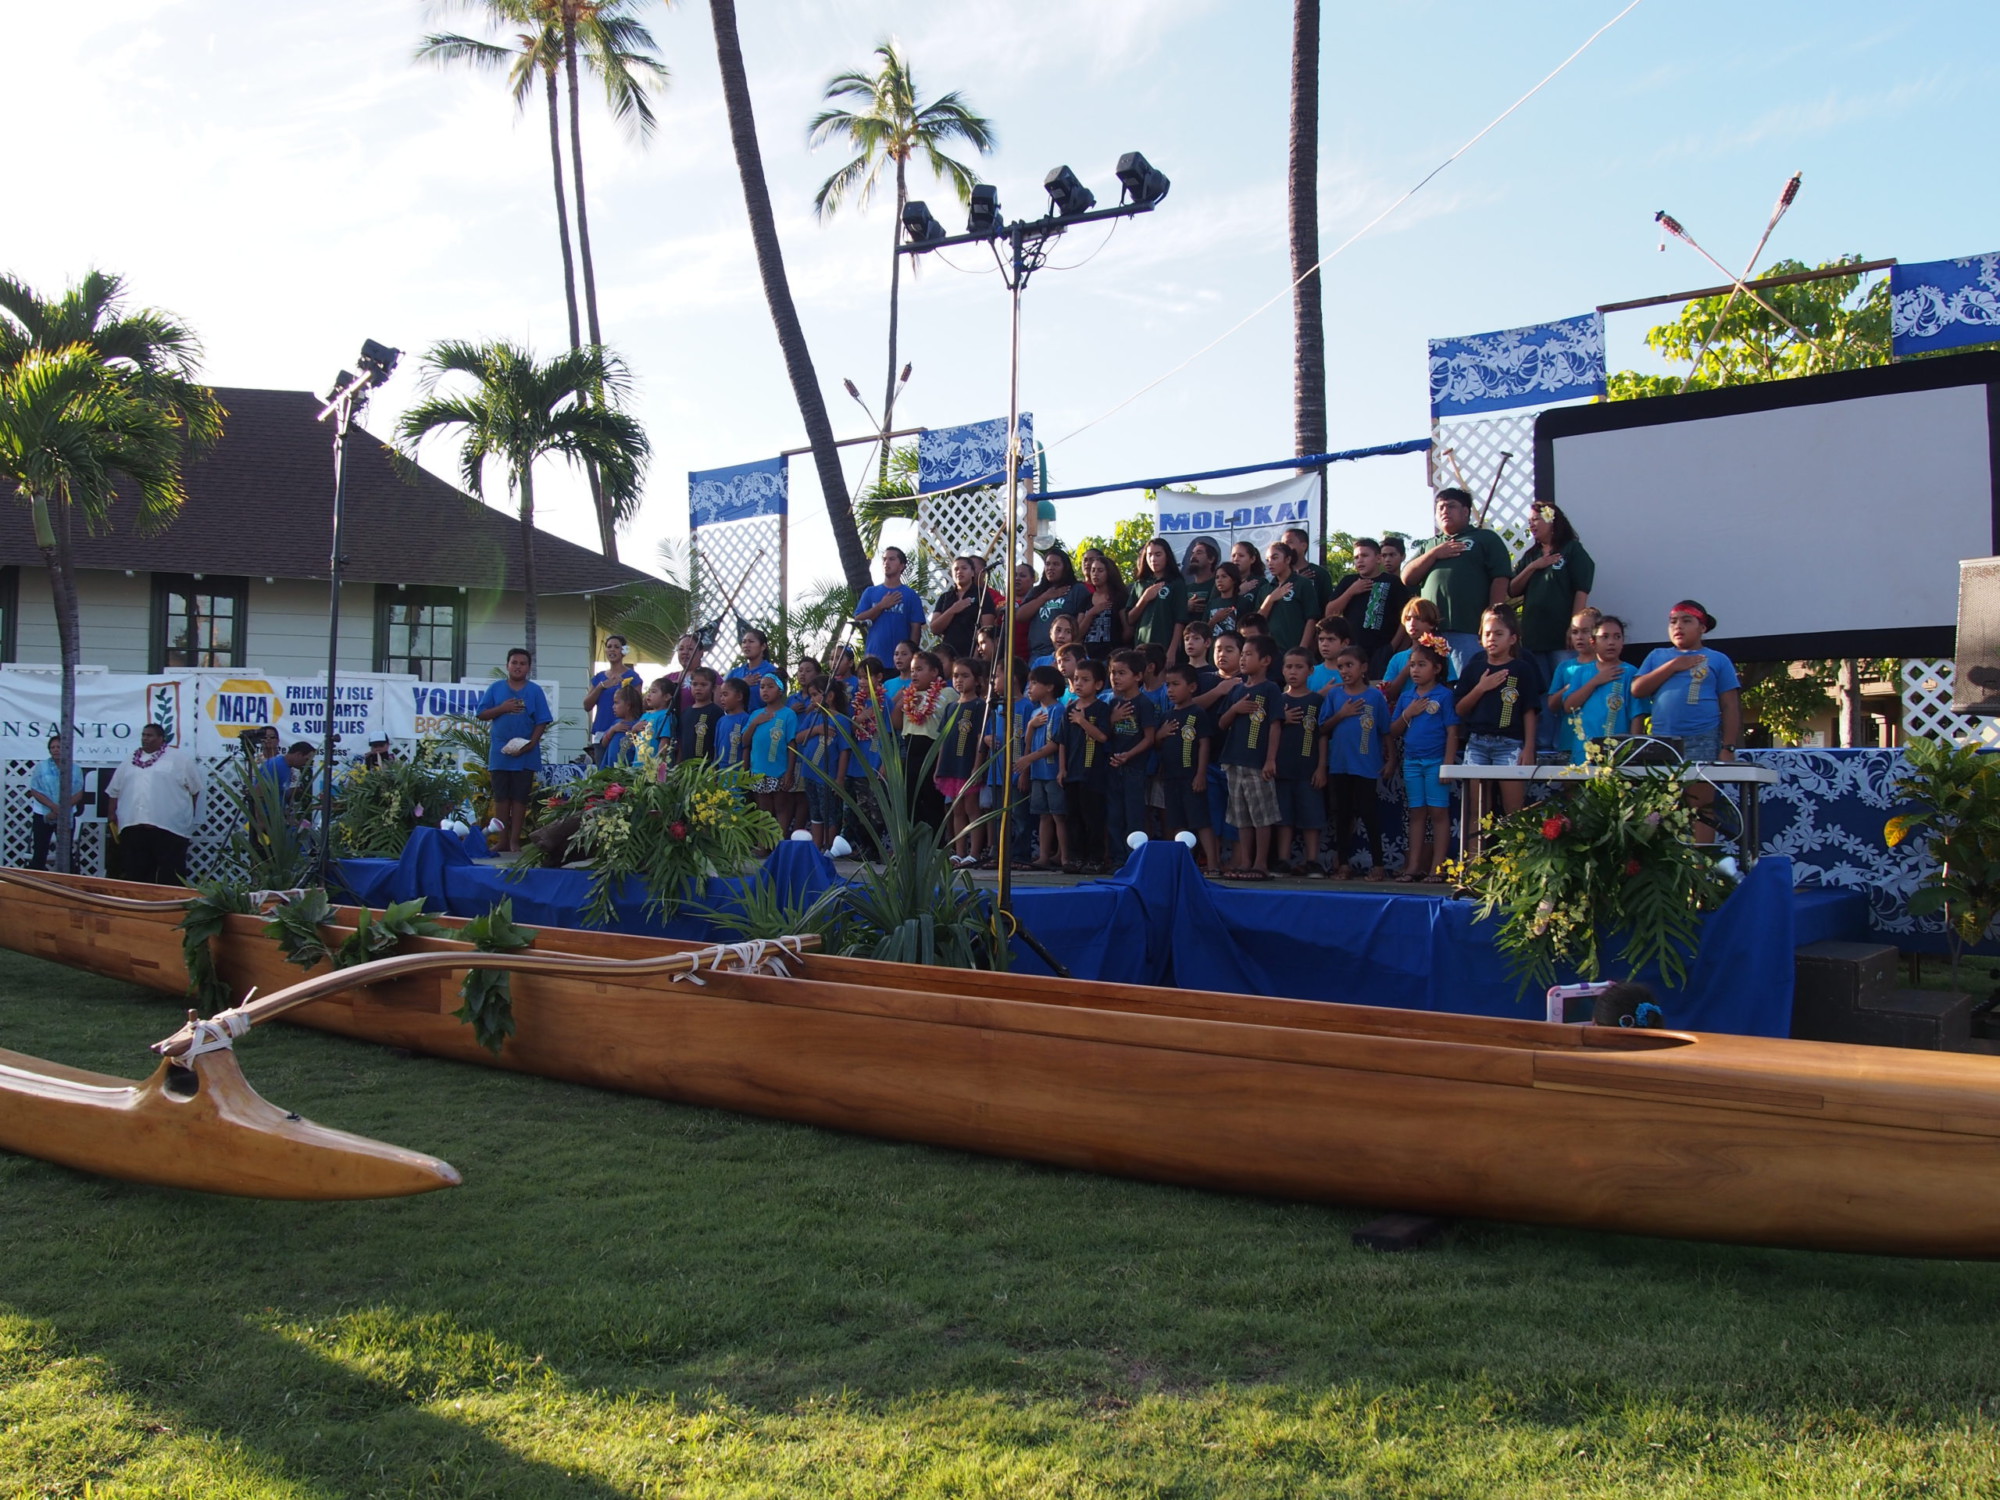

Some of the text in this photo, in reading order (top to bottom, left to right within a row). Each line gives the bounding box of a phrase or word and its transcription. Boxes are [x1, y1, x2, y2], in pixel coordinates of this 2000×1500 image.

[347, 686, 373, 700] ISLE
[218, 694, 268, 724] NAPA
[412, 687, 484, 716] YOUN
[289, 702, 368, 718] AUTO ARTS
[292, 721, 301, 734] &
[76, 746, 128, 755] AWAII
